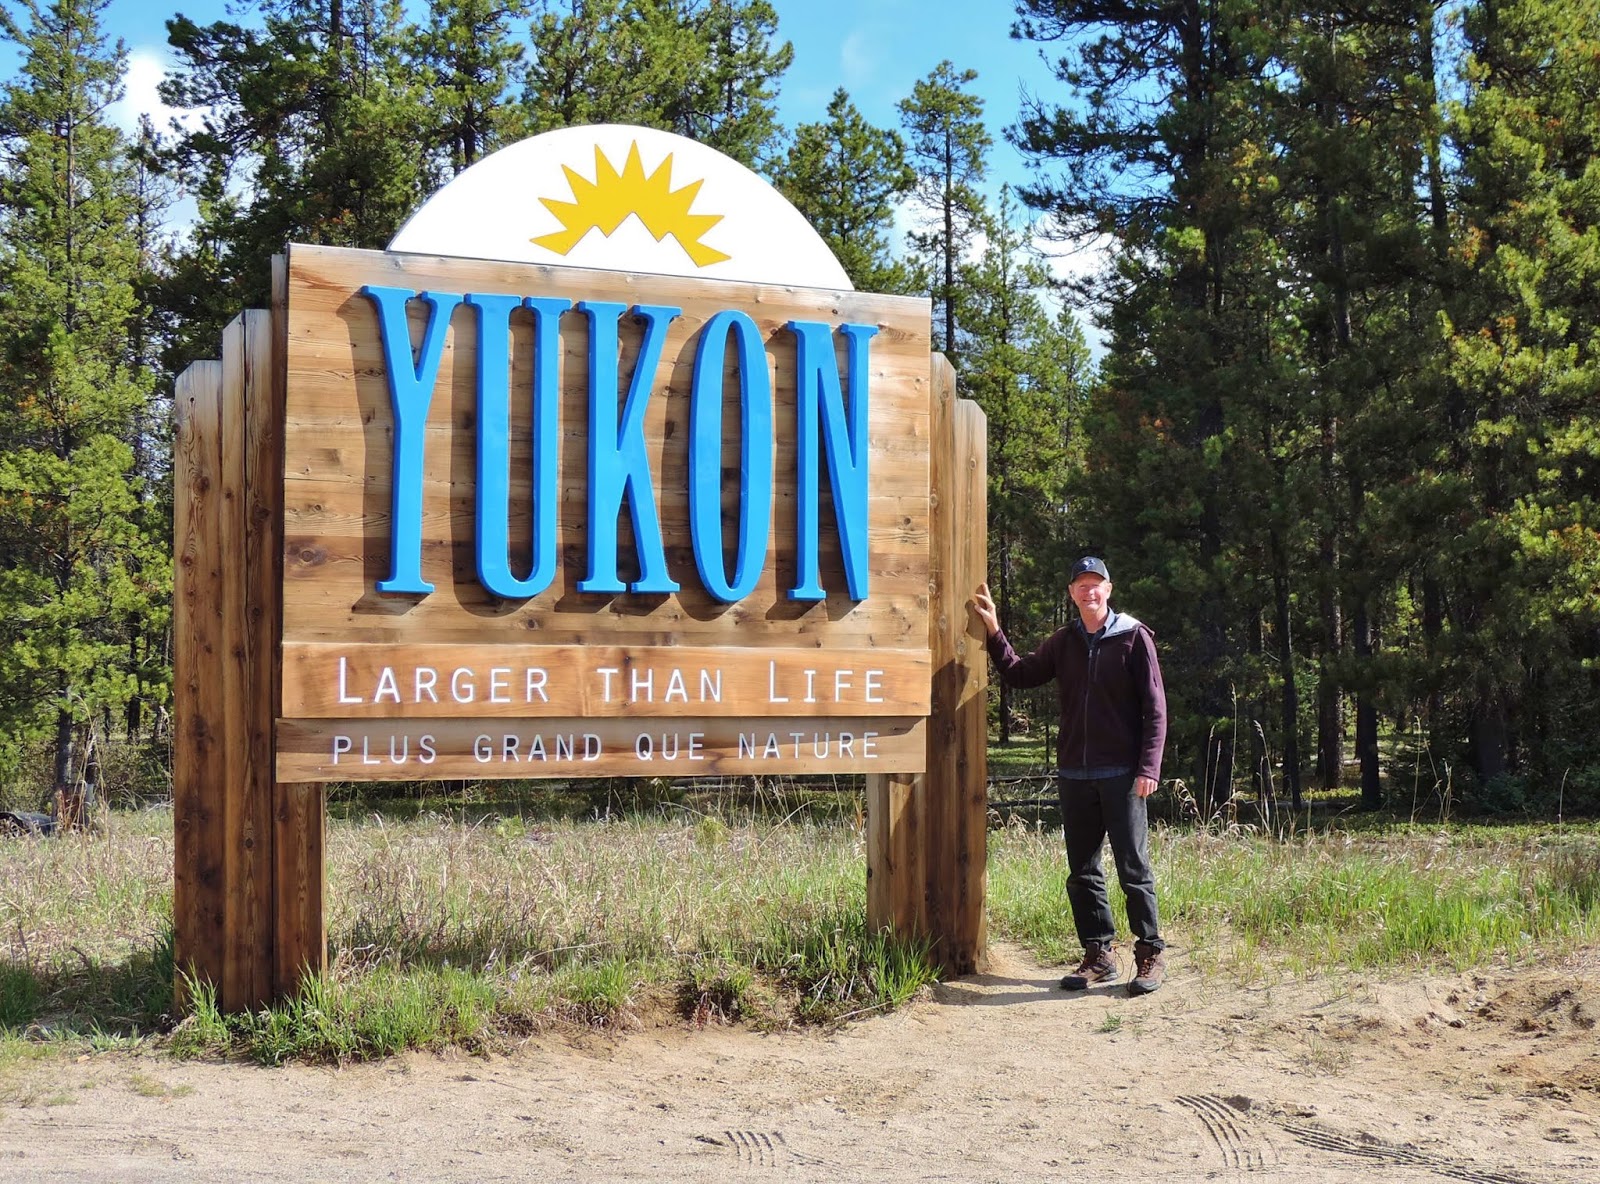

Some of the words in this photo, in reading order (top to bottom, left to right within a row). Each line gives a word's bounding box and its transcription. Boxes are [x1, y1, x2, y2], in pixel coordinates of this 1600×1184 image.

[361, 285, 878, 602] YUKON
[597, 668, 722, 703] THAN
[333, 735, 436, 764] PLUS
[474, 734, 602, 763] GRAND
[636, 733, 705, 761] QUE
[738, 731, 880, 760] NATURE
